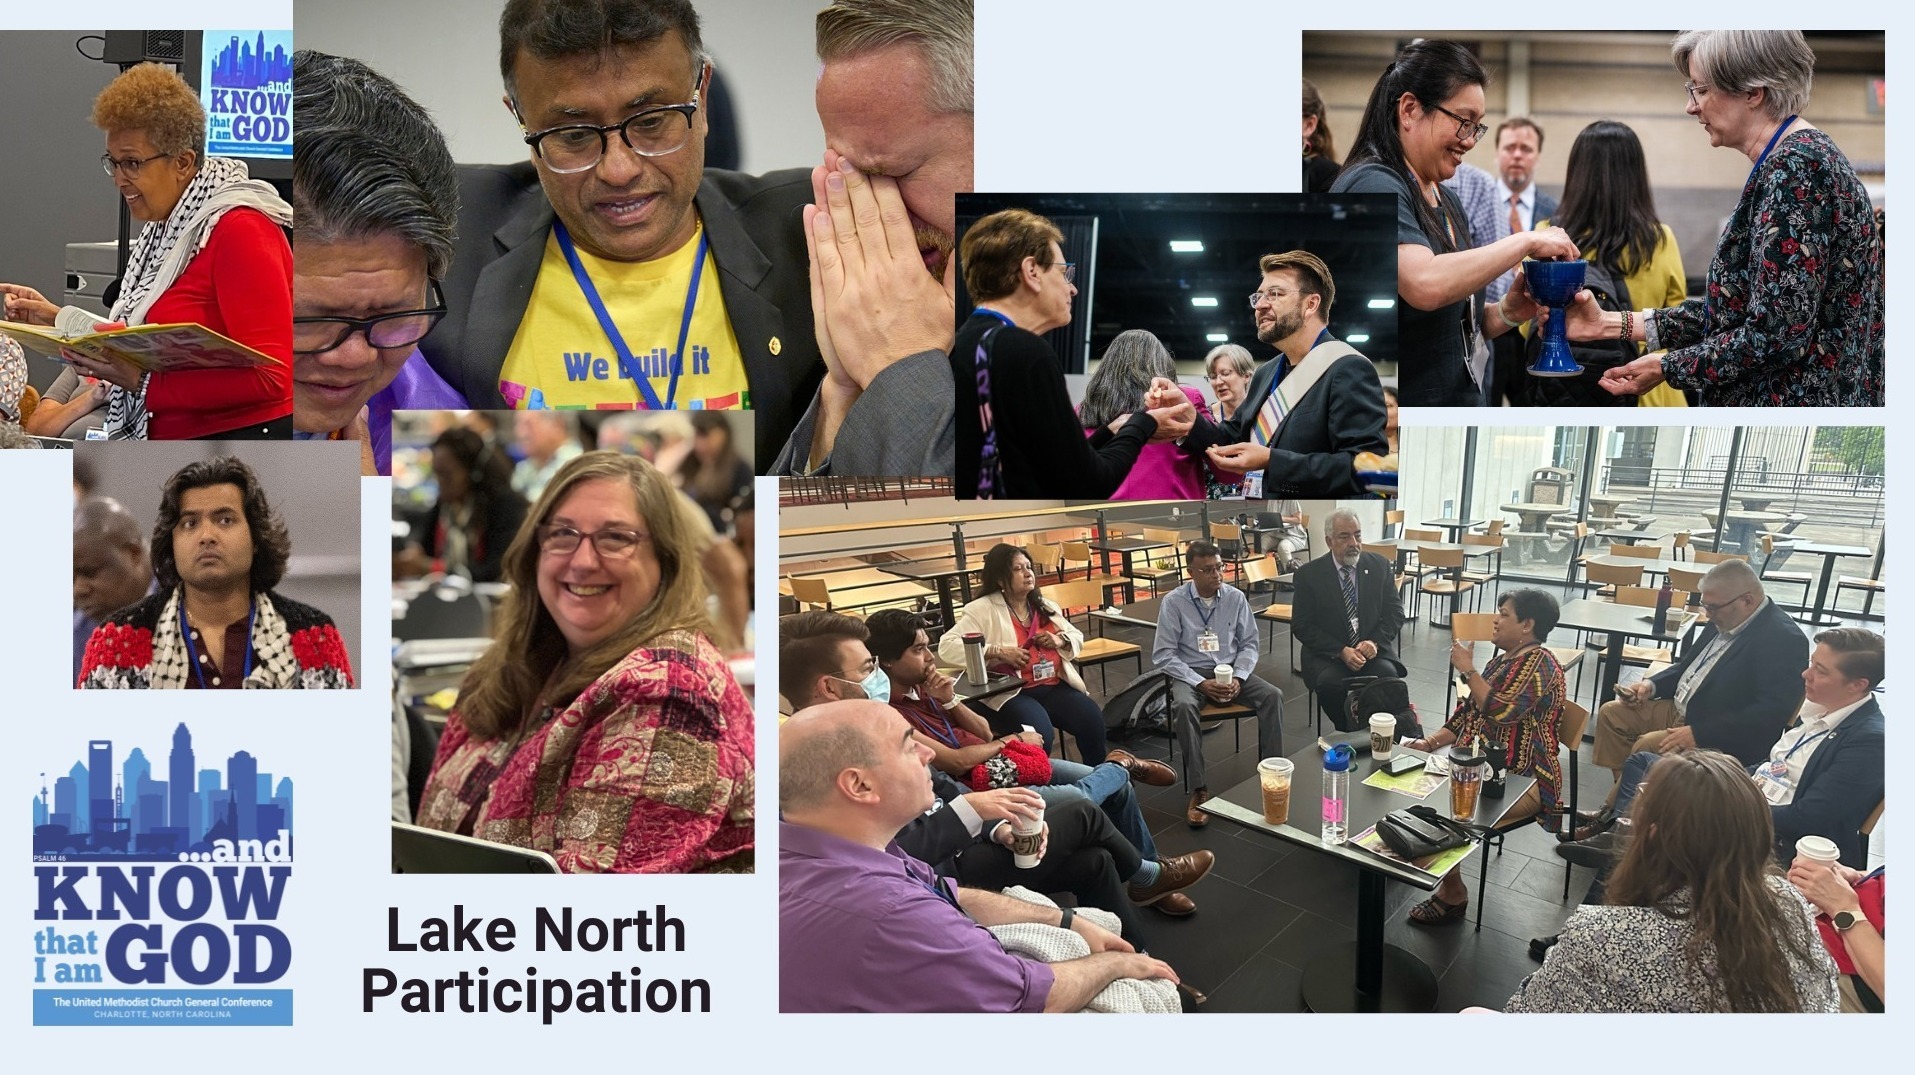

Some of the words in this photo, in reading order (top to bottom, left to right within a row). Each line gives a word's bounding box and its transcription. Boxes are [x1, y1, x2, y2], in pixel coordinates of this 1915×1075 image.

[210, 89, 292, 116] KNOW
[209, 128, 213, 139] I
[216, 130, 231, 140] am
[210, 115, 230, 128] that
[232, 115, 290, 142] GOD
[563, 353, 609, 381] We
[692, 345, 710, 374] it
